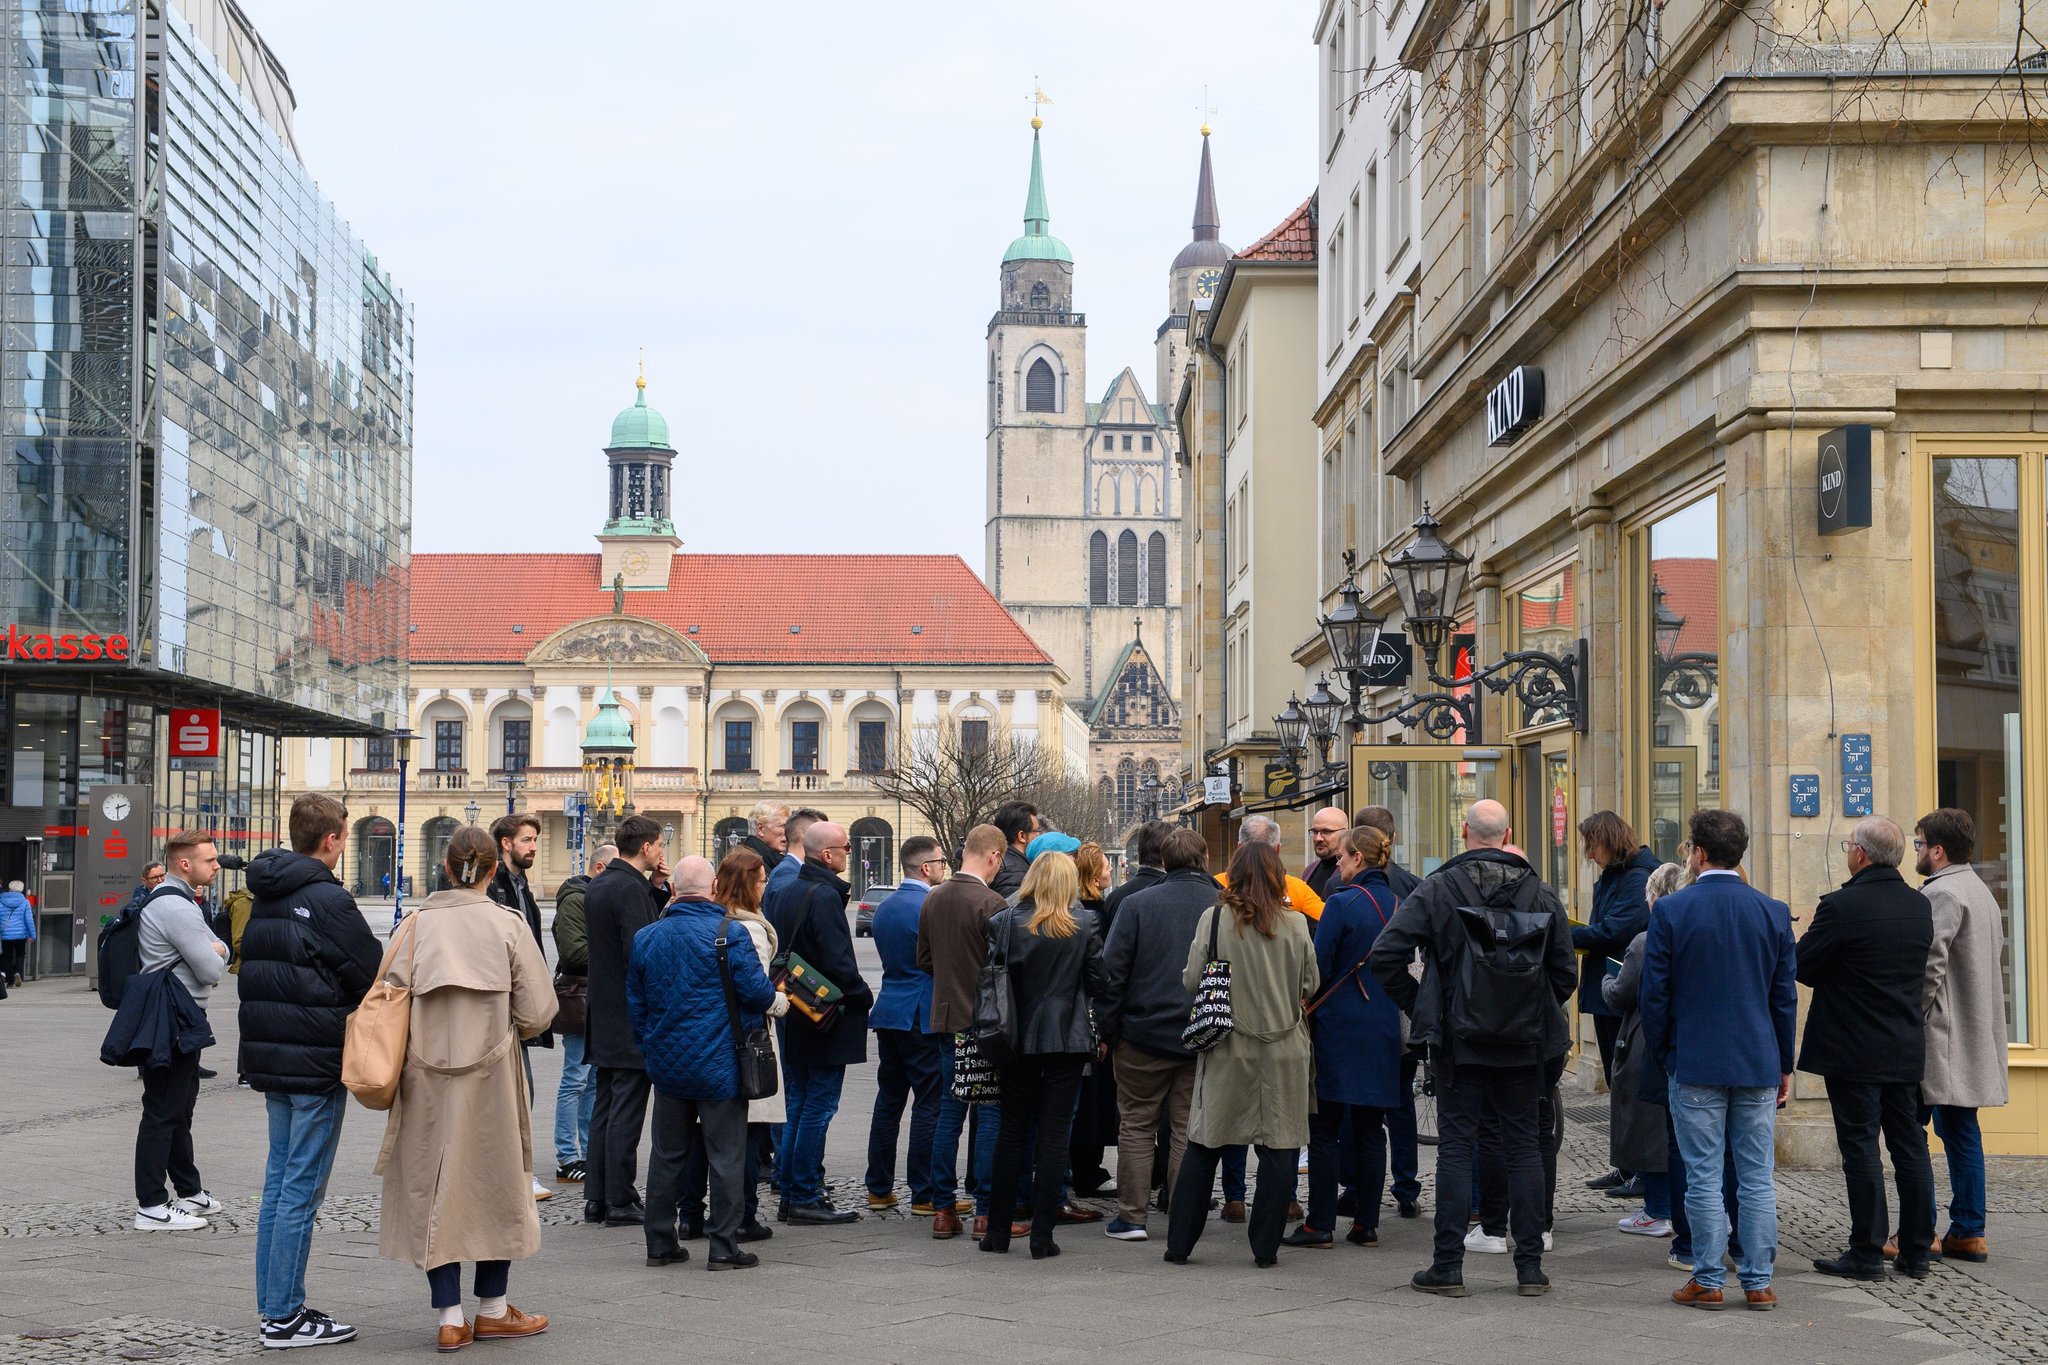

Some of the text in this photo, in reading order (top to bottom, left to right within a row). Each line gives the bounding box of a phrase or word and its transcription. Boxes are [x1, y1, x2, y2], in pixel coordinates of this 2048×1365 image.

[1486, 364, 1524, 448] KIND
[1822, 470, 1841, 492] KIND
[1845, 742, 1850, 752] S
[1792, 783, 1798, 793] S
[1846, 783, 1871, 794] S 150
